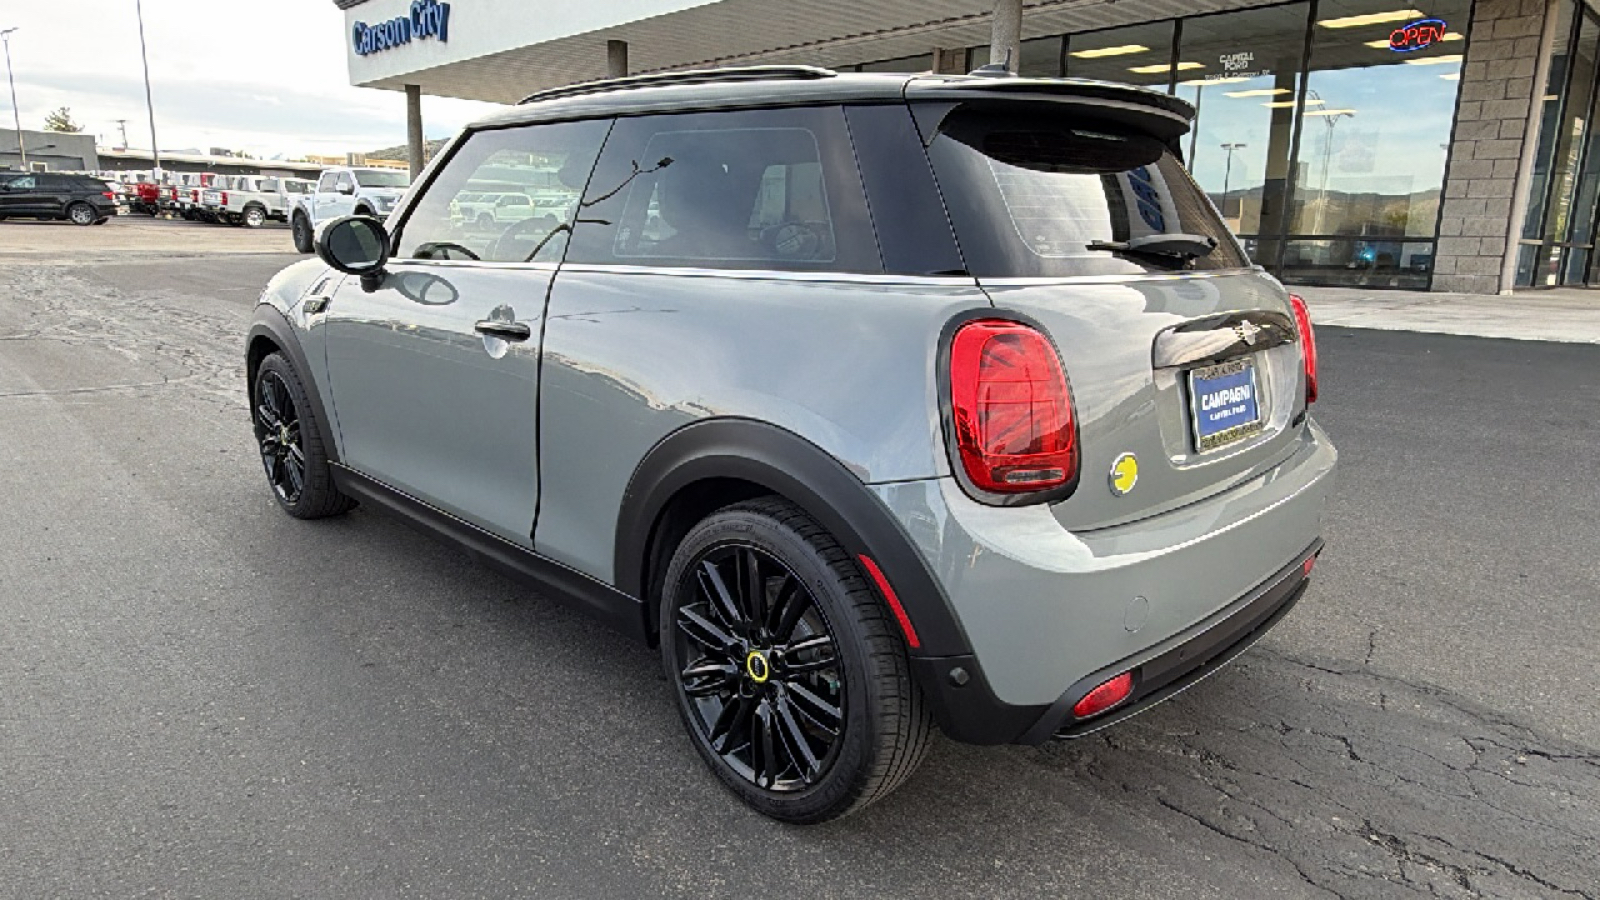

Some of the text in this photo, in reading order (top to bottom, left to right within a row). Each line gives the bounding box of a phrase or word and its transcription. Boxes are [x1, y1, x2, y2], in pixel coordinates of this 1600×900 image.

[353, 0, 449, 55] Carson City
[1389, 24, 1445, 47] OPEN
[1224, 61, 1249, 71] FORD
[1202, 384, 1251, 411] CAMPAGNI
